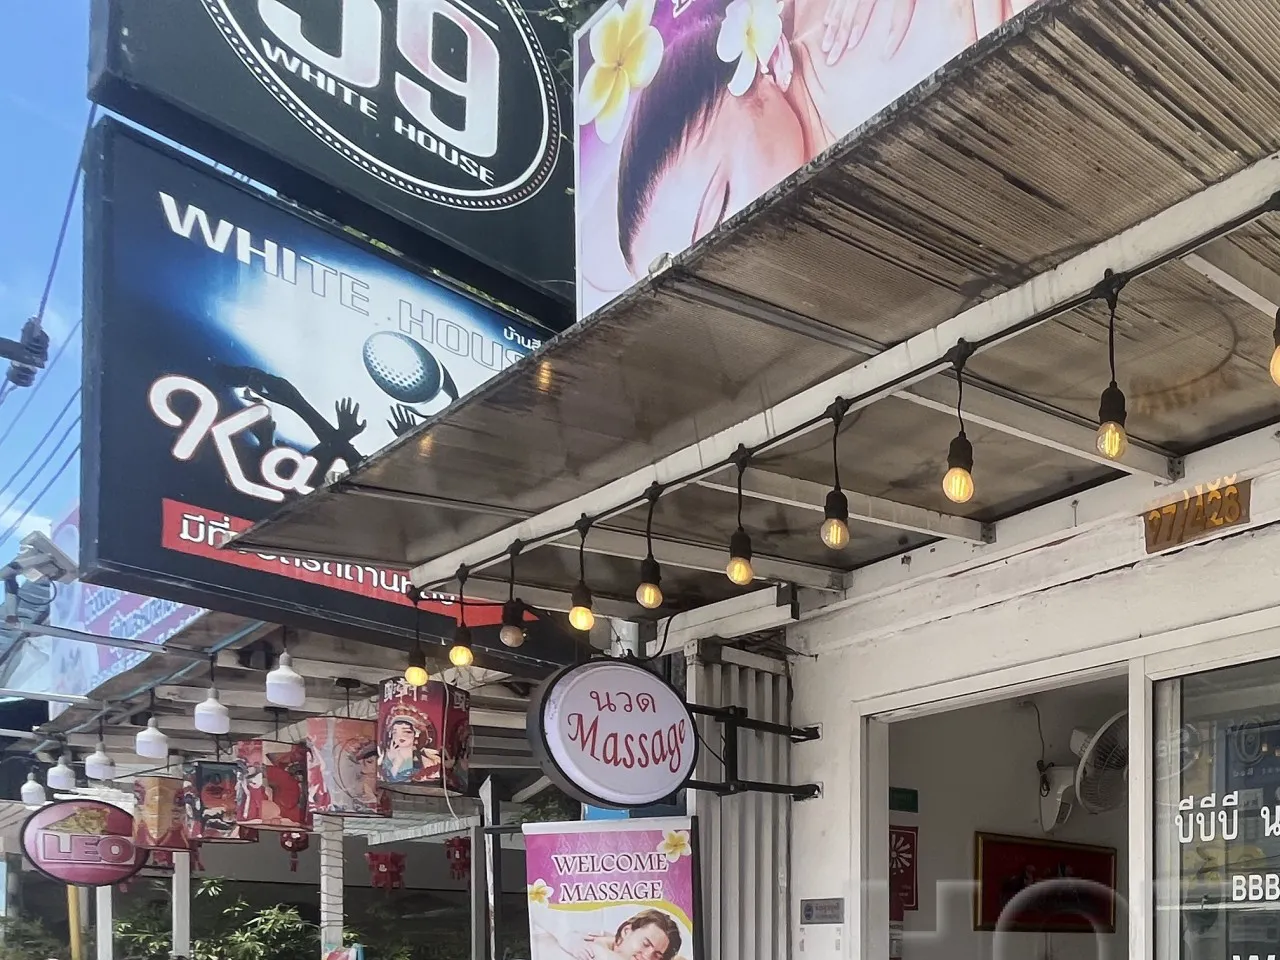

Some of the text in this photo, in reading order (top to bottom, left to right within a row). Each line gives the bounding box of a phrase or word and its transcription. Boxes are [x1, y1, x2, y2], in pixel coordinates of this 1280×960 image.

[260, 37, 495, 187] WHITE HOUSE
[159, 191, 370, 316] WHITE
[589, 690, 656, 713] นวด
[567, 712, 686, 774] Massage
[1175, 790, 1240, 844] บีบีบี
[43, 833, 134, 863] LEO
[553, 852, 668, 875] WELCOME
[560, 881, 663, 902] MASSAGE
[1231, 872, 1280, 902] BBB
